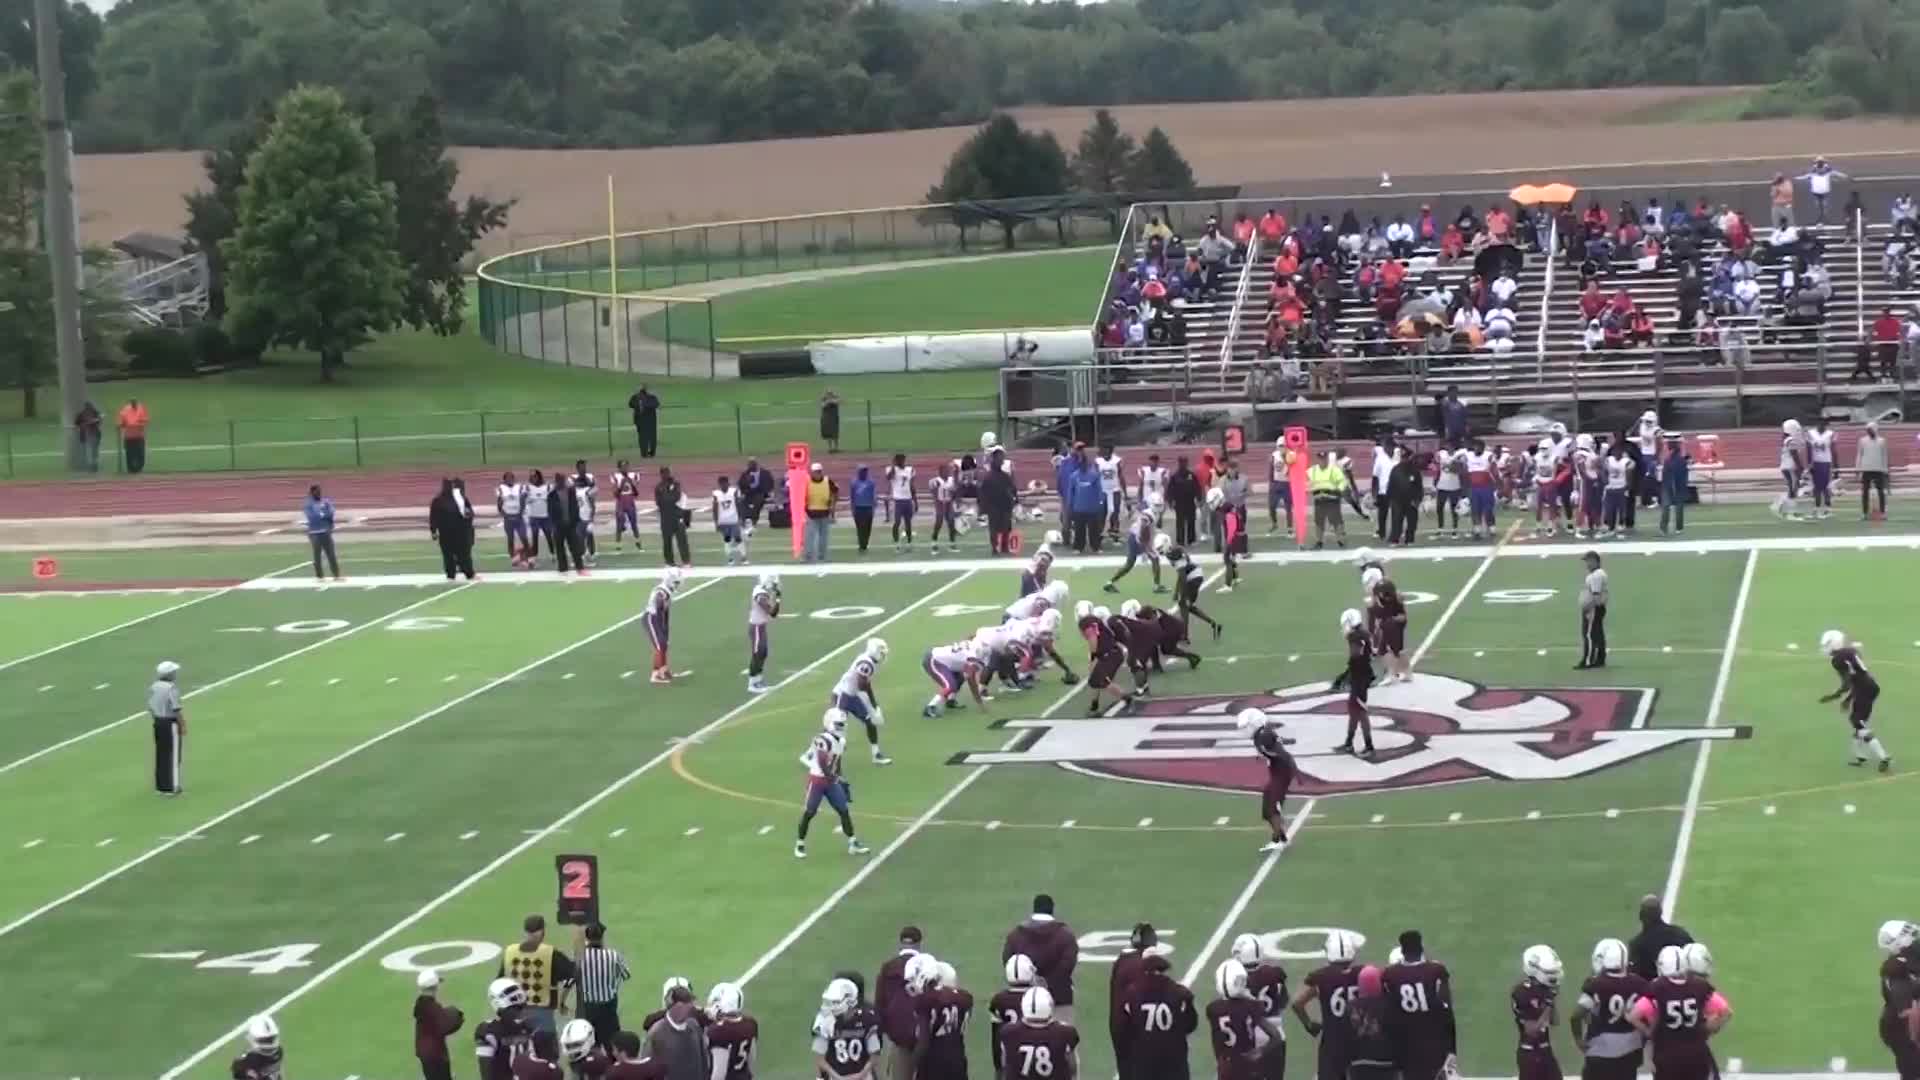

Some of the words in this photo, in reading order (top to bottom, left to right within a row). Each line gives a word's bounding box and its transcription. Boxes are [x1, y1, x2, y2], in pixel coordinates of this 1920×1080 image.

[562, 860, 592, 898] 2
[195, 940, 503, 974] 40
[1400, 982, 1429, 1013] 81
[1140, 1002, 1173, 1031] 70
[1666, 998, 1699, 1029] 55
[834, 1038, 863, 1063] 80
[1018, 1046, 1053, 1077] 78
